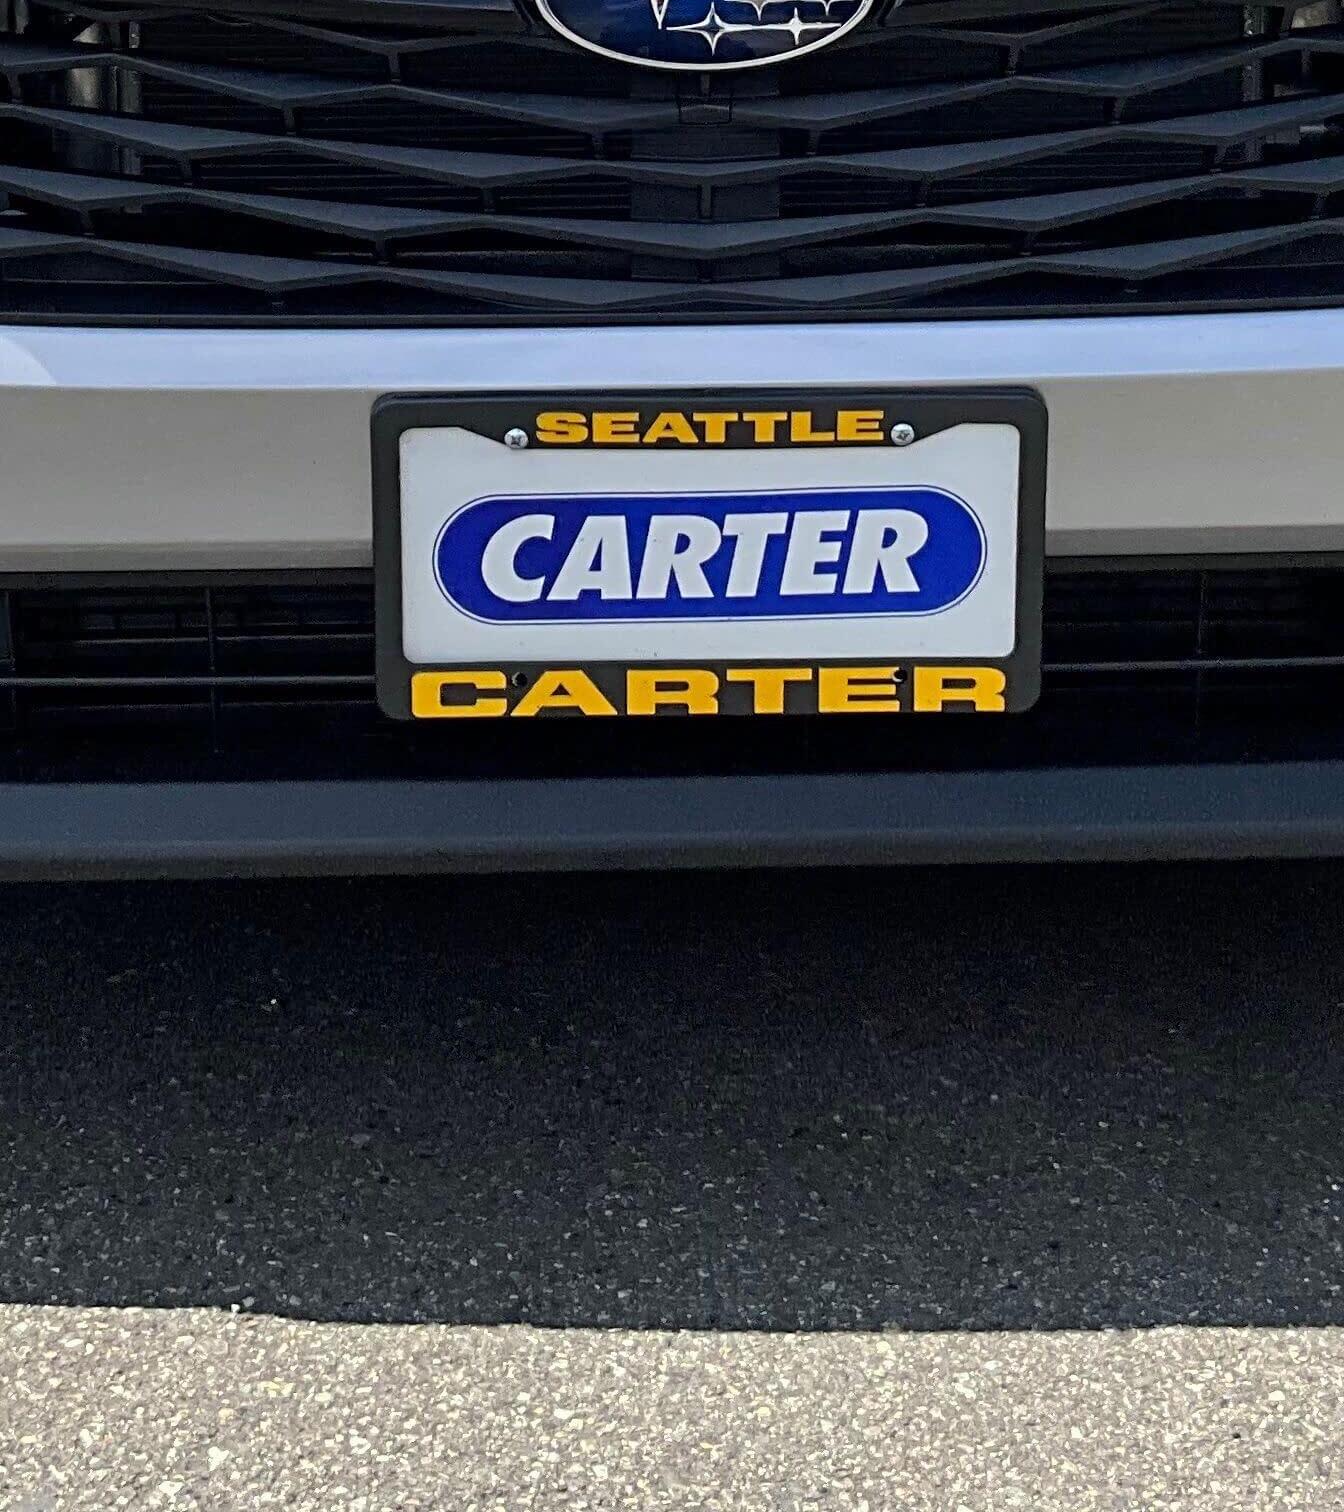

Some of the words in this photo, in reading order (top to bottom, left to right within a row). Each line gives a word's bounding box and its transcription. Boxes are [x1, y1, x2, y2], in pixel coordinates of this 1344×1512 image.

[535, 410, 885, 444] SEATTLE
[481, 508, 929, 603] CARTER
[410, 666, 1007, 719] CARTER
